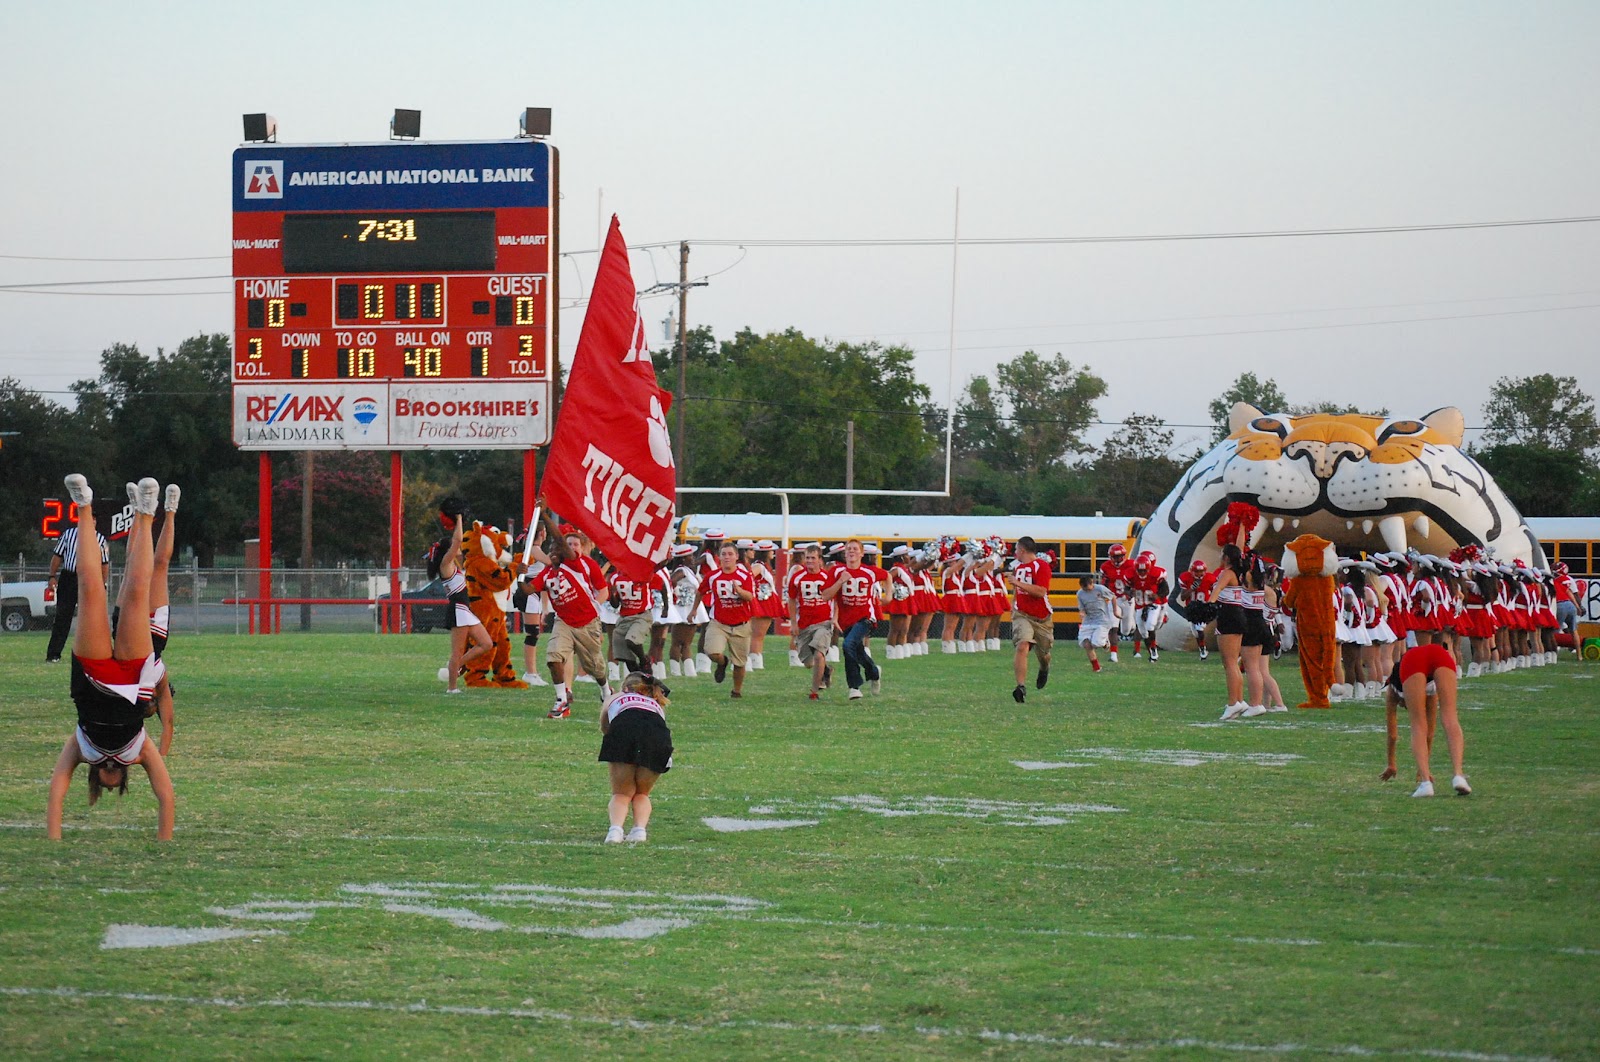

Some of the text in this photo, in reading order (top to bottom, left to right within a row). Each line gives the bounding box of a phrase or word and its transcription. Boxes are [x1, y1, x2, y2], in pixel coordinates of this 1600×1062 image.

[289, 168, 534, 186] AMERICAN NATIONAL BANK
[358, 219, 417, 241] 7:31
[243, 280, 290, 298] HOME
[488, 277, 542, 295] GUEST
[364, 284, 384, 319] 0
[516, 296, 534, 325] 0
[268, 299, 285, 328] 0
[282, 333, 321, 347] DOWN
[336, 332, 377, 346] TO GO
[395, 331, 450, 346] BALL ON
[466, 331, 492, 346] QTR
[519, 335, 533, 356] 3
[236, 362, 271, 376] T.O.L.
[348, 348, 375, 377] 10
[404, 348, 441, 377] 40
[509, 360, 544, 374] T.O.L.
[246, 393, 345, 425] RE/MAX
[395, 398, 539, 417] BROOKSHIRE'S
[247, 427, 344, 440] LANDMARK
[418, 421, 518, 439] Food Stores
[842, 577, 869, 597] BG
